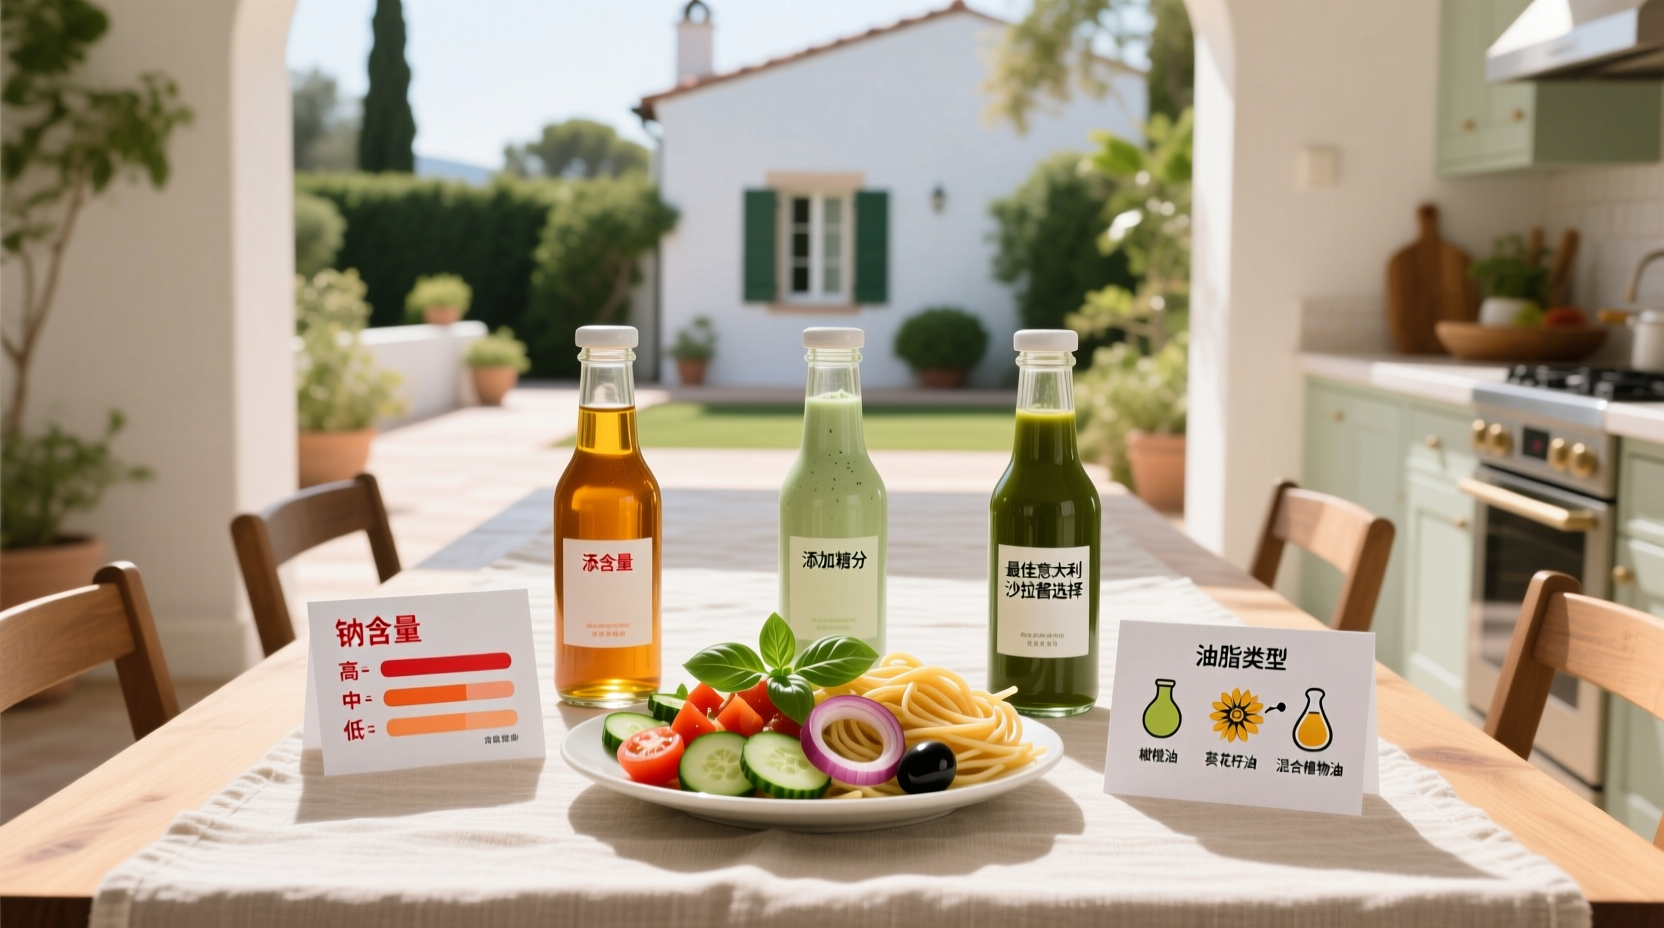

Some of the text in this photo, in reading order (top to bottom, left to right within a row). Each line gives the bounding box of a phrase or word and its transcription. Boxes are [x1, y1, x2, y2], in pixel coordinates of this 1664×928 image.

[802, 550, 867, 570] 添加糖分
[1005, 580, 1083, 599] 沙拉酱选择
[335, 614, 422, 647] 钠含量
[1196, 644, 1288, 671] 油脂类型
